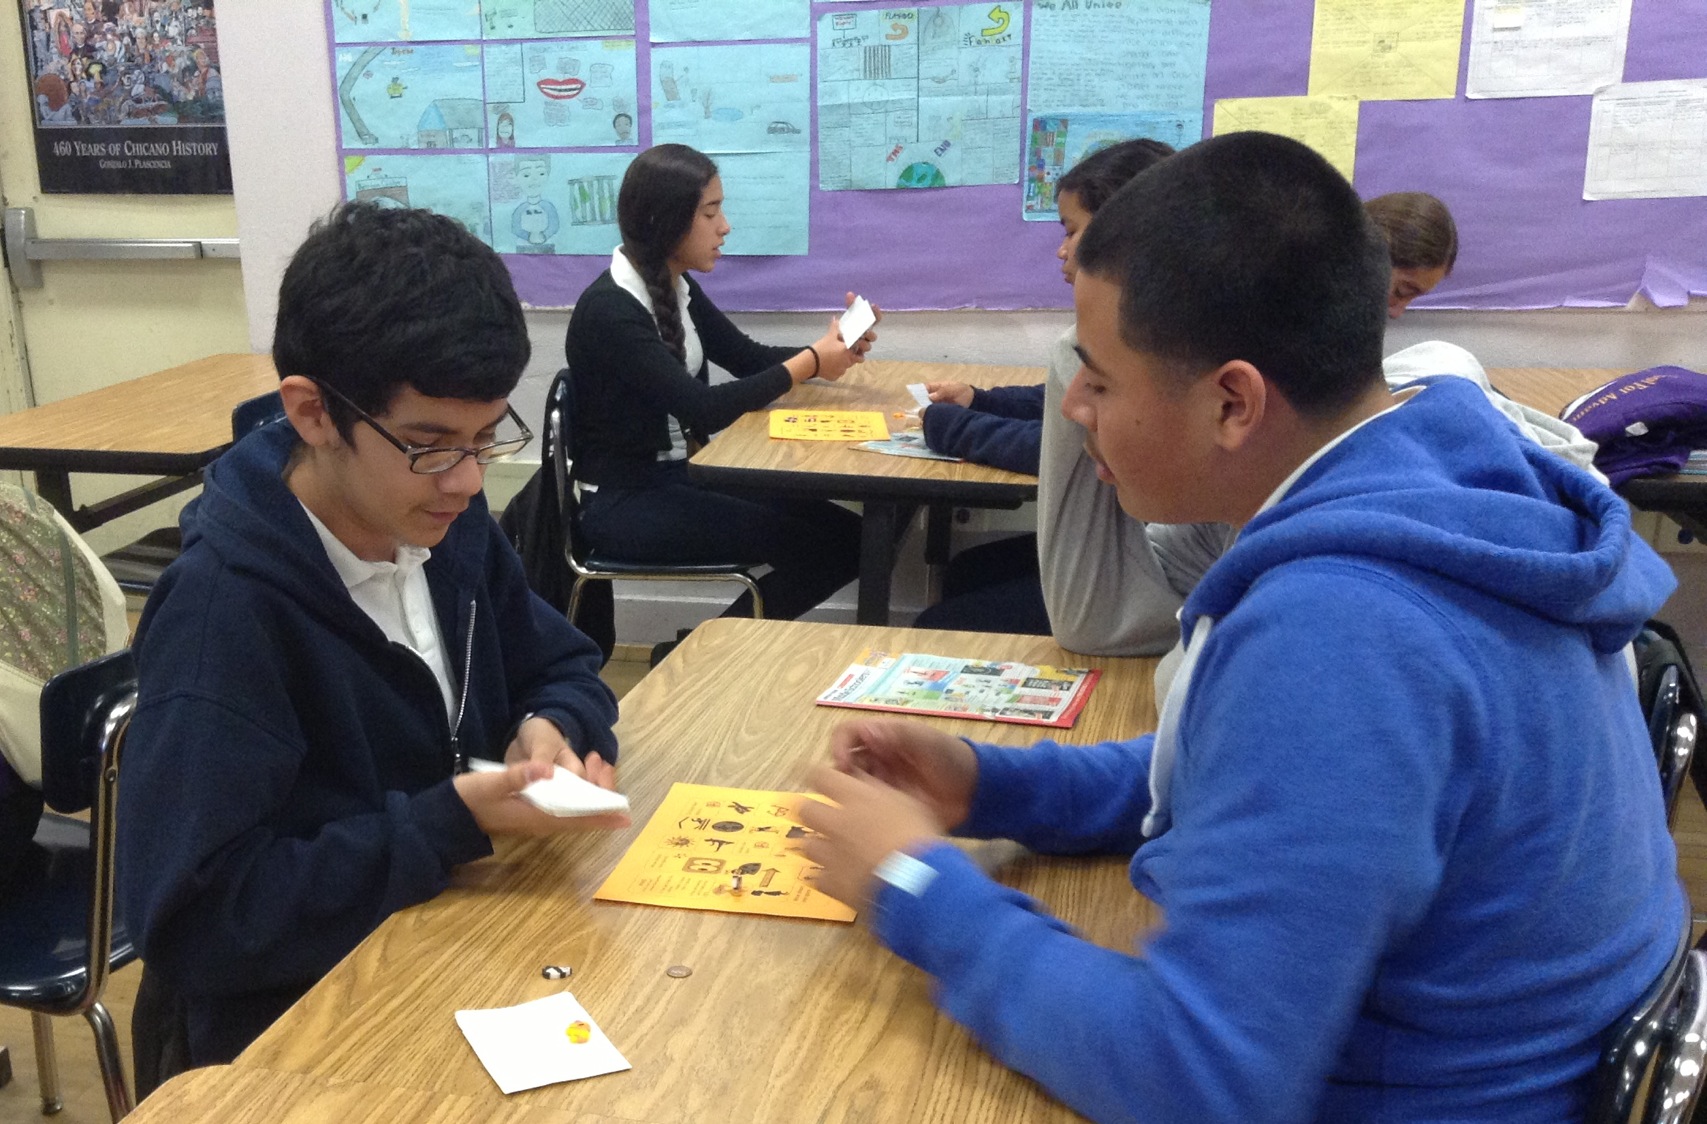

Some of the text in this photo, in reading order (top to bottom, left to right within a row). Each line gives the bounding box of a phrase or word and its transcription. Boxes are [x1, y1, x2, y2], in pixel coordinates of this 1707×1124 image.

[53, 140, 218, 156] 460 YEARS OF CHICANO HISTORY
